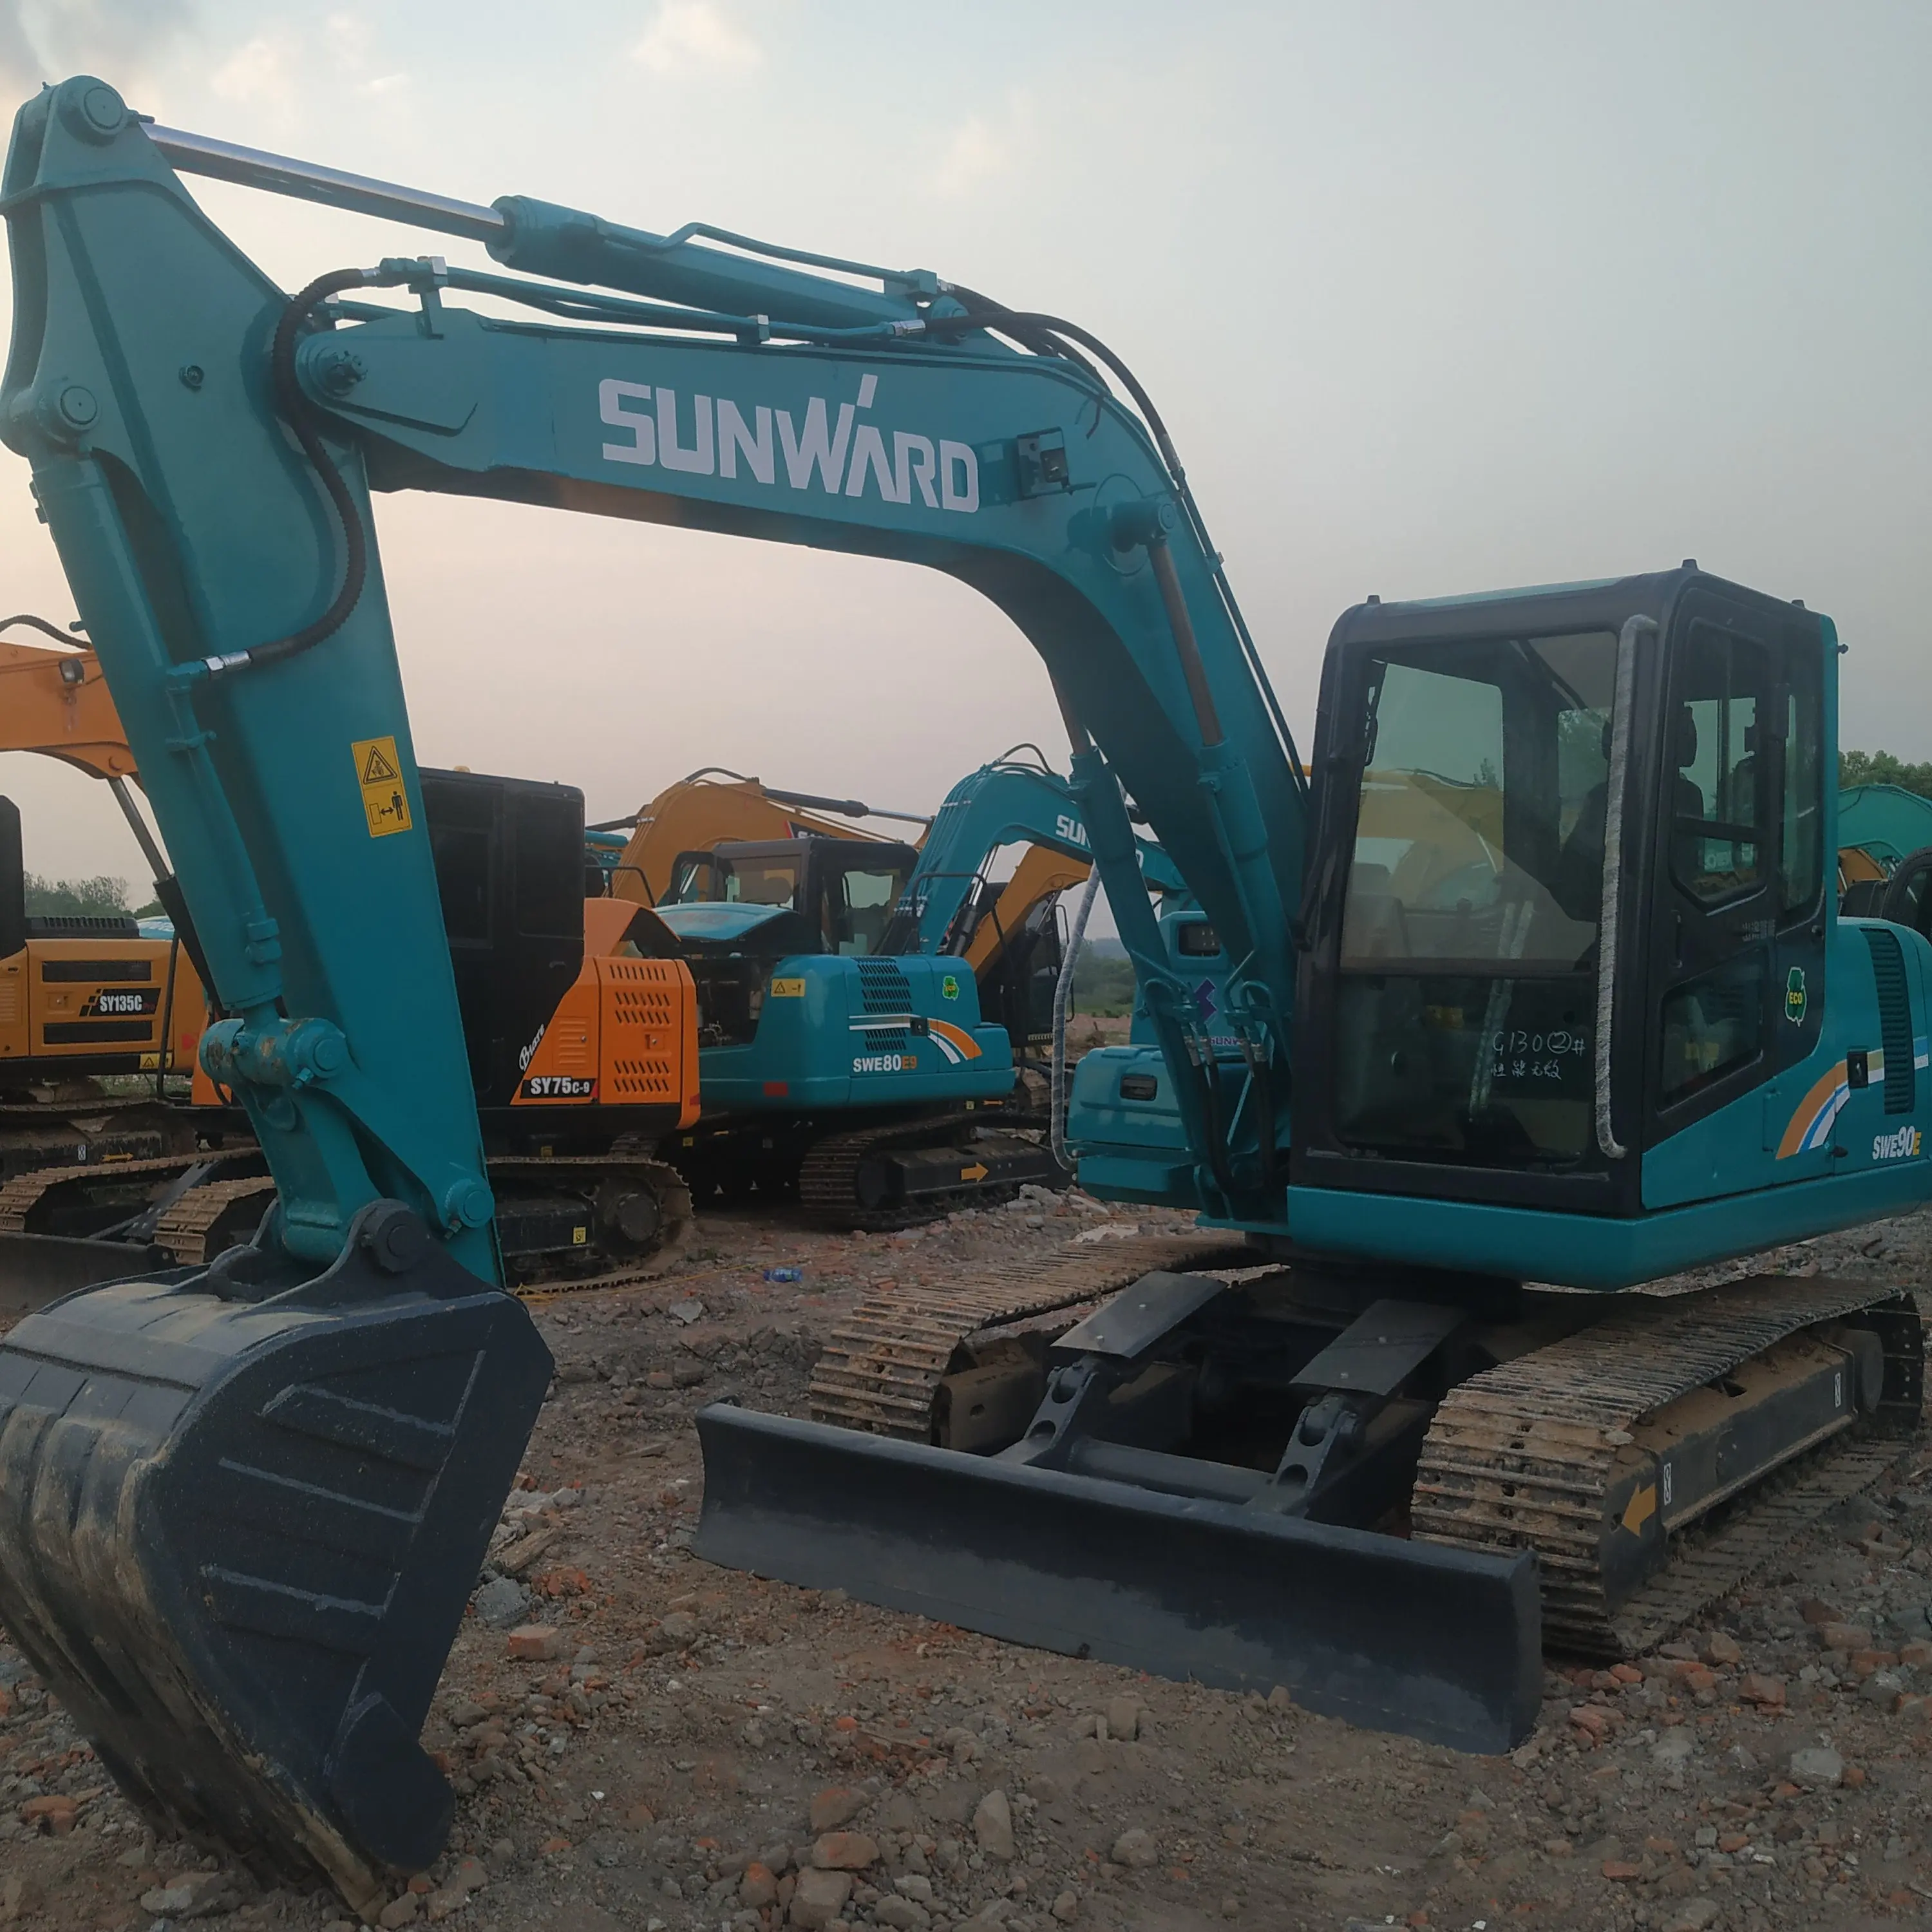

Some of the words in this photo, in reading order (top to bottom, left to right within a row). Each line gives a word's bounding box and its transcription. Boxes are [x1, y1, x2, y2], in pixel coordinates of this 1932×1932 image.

[598, 374, 980, 513] SUNWARD
[99, 994, 142, 1012] SY135C
[1789, 992, 1803, 1005] ECO
[1871, 1125, 1922, 1160] SWE90E
